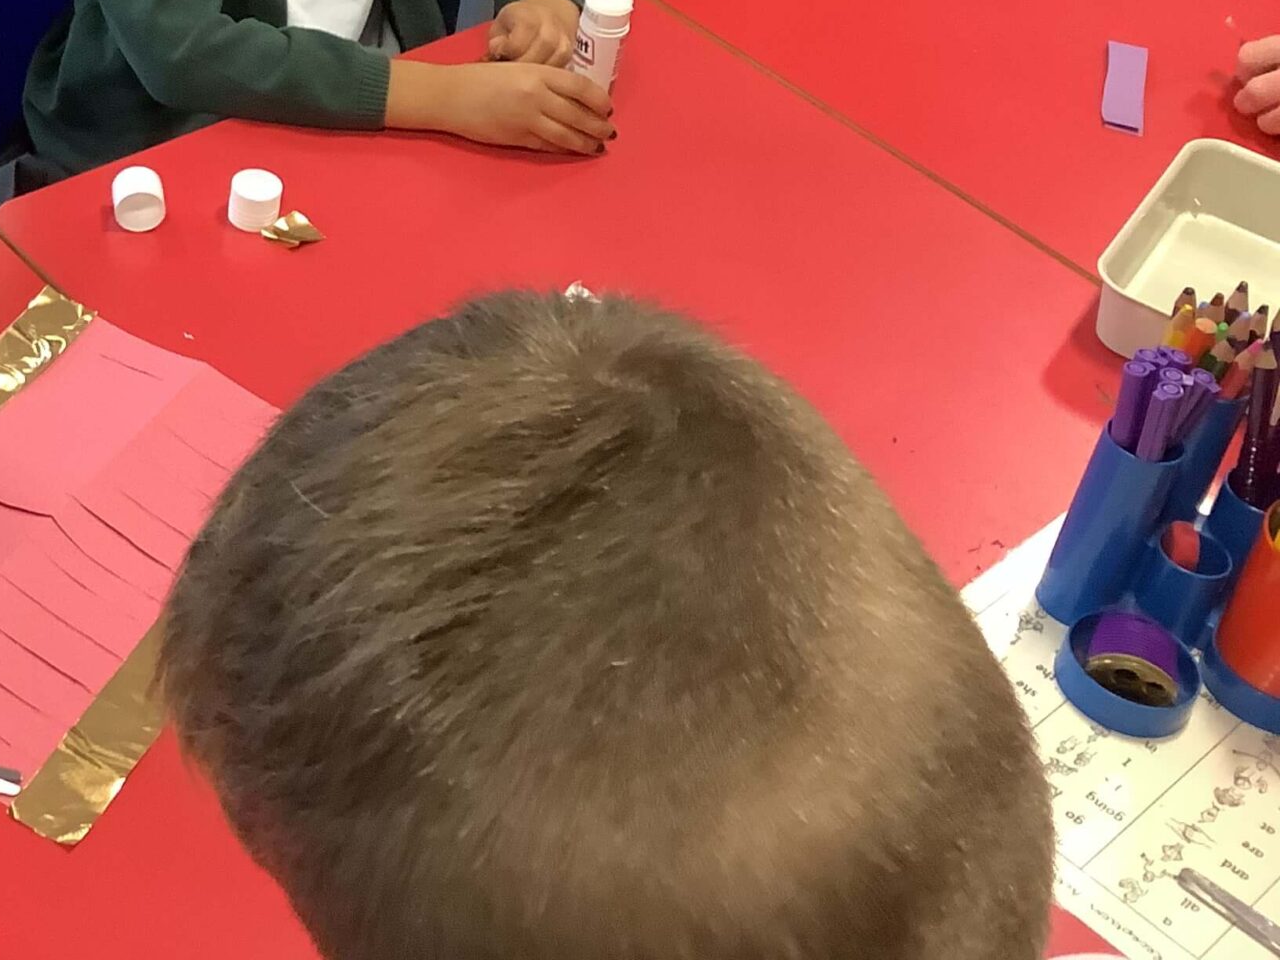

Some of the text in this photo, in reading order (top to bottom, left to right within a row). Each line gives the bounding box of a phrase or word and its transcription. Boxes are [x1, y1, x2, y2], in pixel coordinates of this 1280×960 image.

[1016, 680, 1036, 696] she
[1085, 791, 1126, 822] going
[1065, 811, 1086, 825] go
[1241, 841, 1264, 858] are
[1220, 859, 1250, 881] and
[1180, 897, 1200, 912] all
[1162, 916, 1173, 927] a
